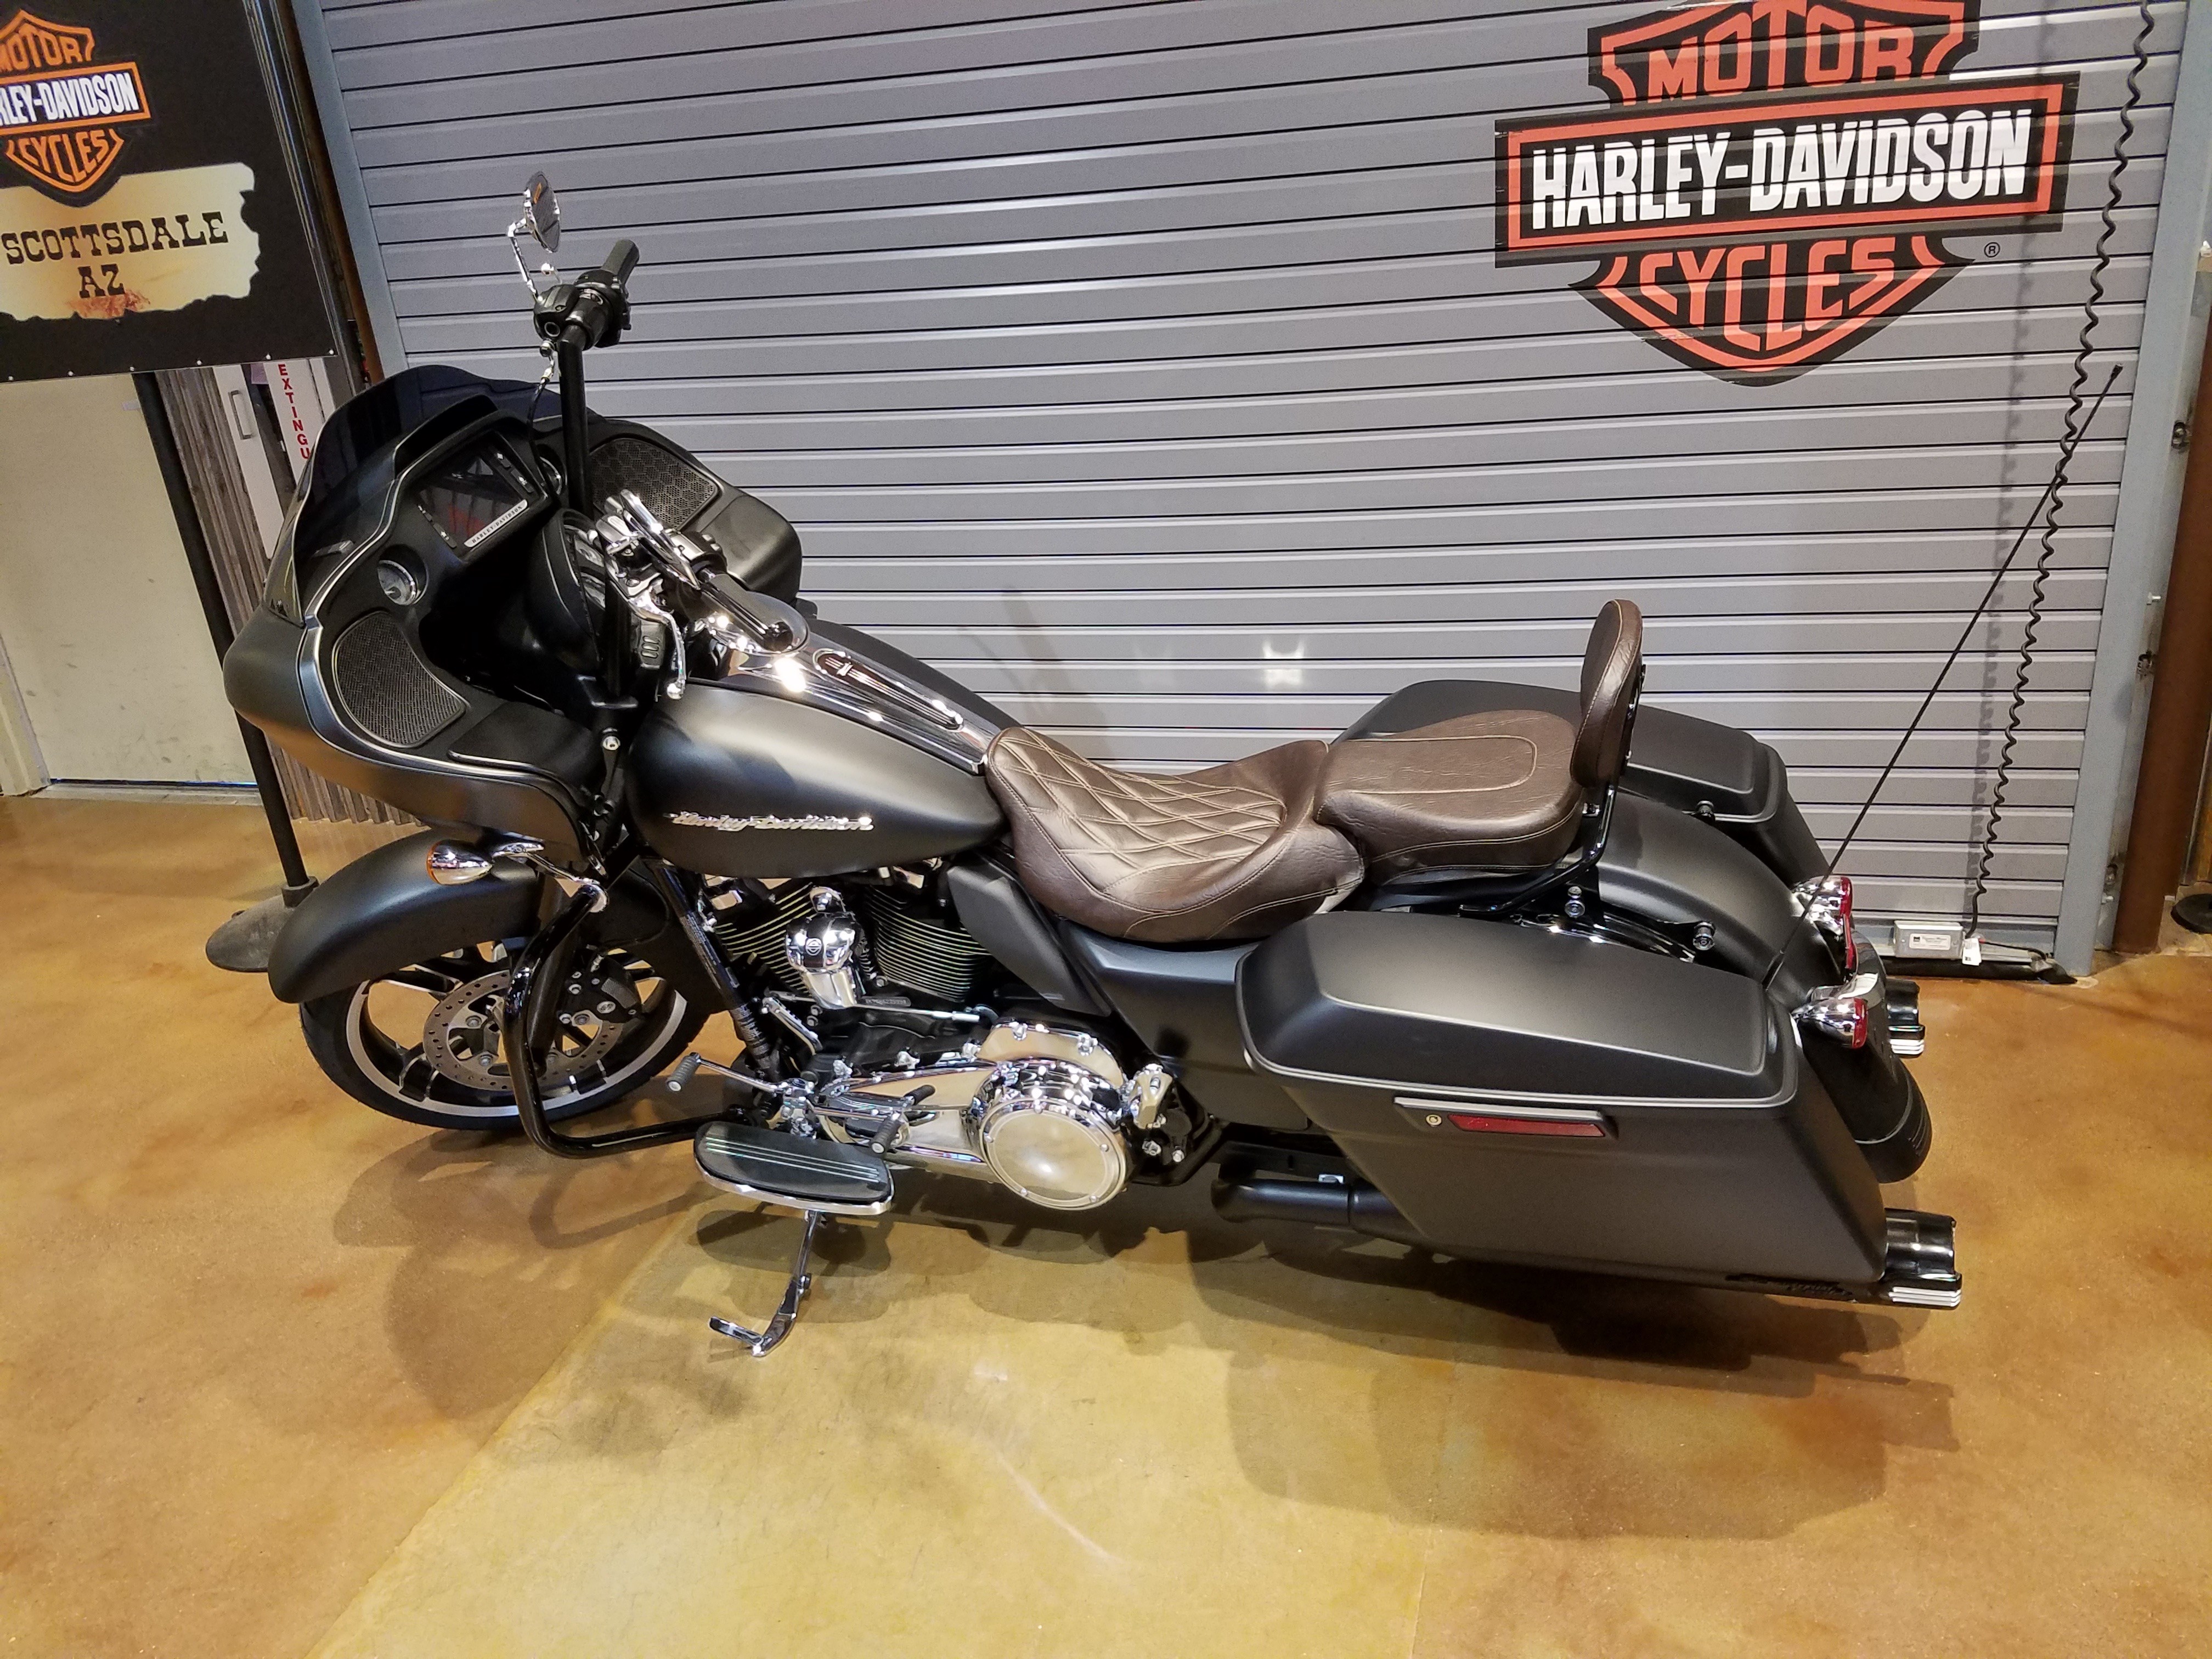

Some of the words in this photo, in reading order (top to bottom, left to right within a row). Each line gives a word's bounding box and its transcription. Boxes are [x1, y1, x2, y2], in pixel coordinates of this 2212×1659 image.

[1647, 0, 1915, 103] MOTOR
[18, 129, 109, 183] CYCLES
[1532, 109, 2032, 230] HARLEY-DAVIDSON
[2, 211, 228, 264] SCOTTSDALE
[78, 264, 125, 298] AZ
[1640, 237, 1896, 352] CYCLES
[472, 505, 523, 544] HARLEY-DAVIDSON
